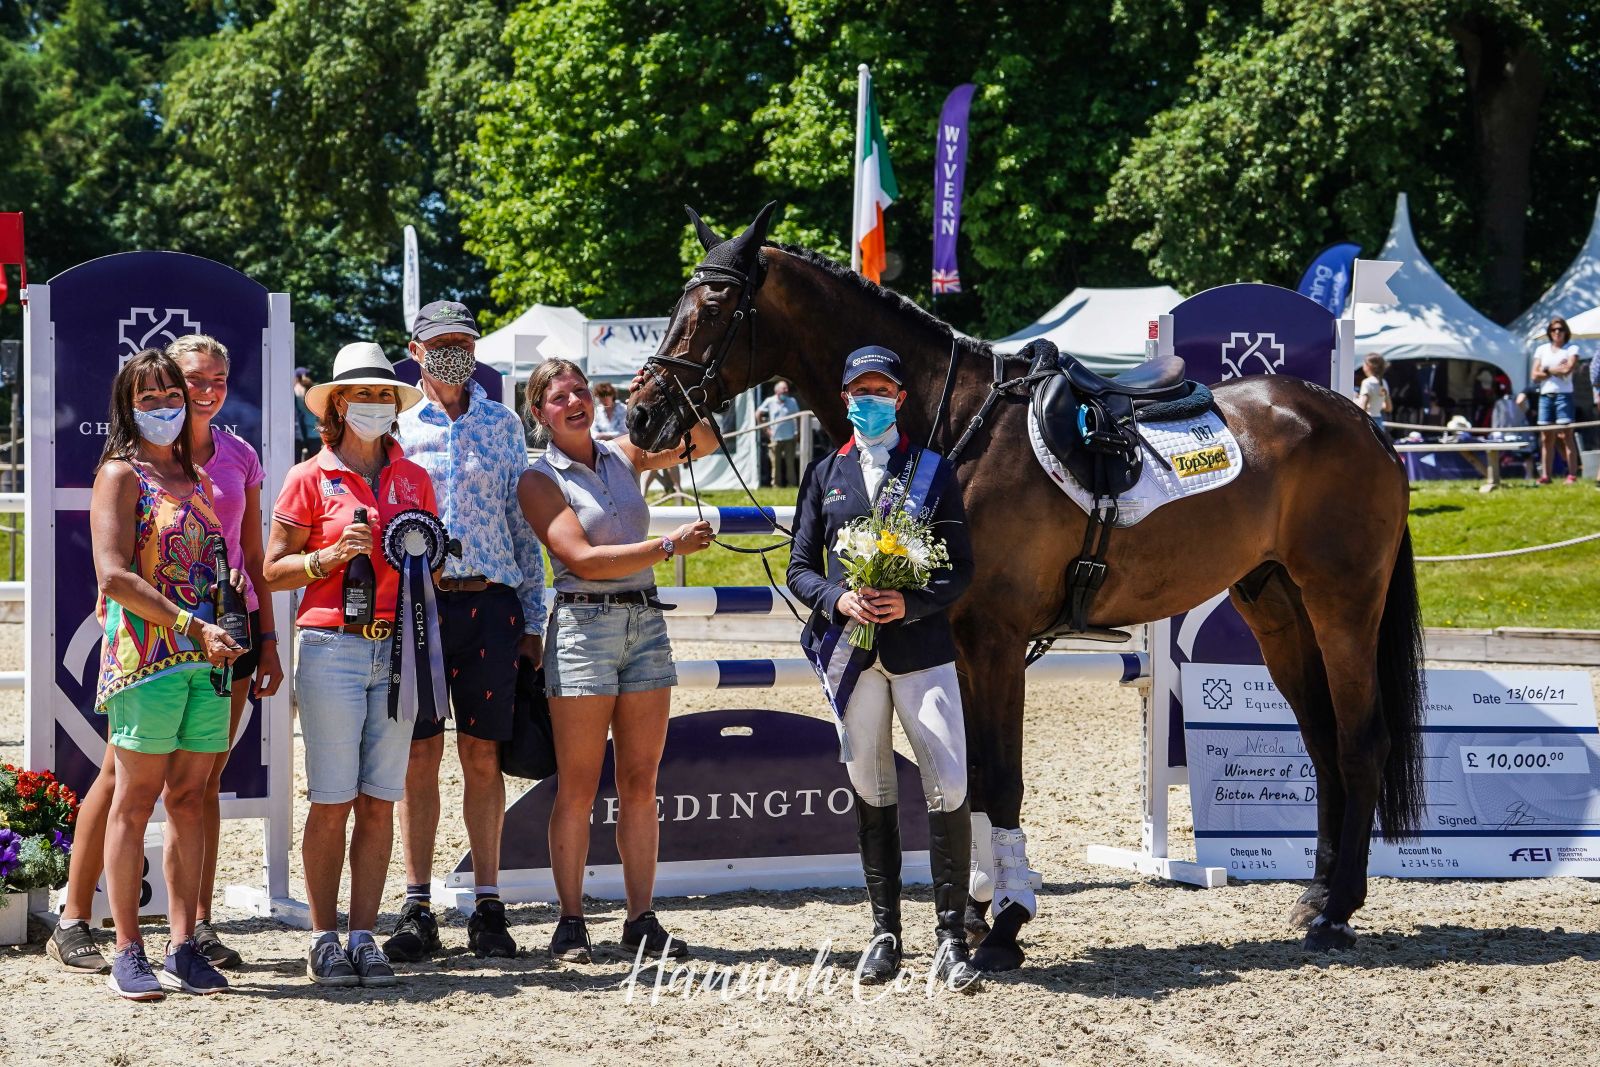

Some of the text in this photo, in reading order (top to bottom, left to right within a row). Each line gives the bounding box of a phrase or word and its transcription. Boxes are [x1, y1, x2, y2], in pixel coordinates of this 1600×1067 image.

[941, 124, 960, 236] WYVERN
[1191, 424, 1215, 441] 087
[1175, 450, 1227, 472] TopSpec
[1243, 681, 1277, 692] CHE
[1472, 685, 1565, 705] Date 13/06/21
[1245, 697, 1289, 713] Equest
[1425, 704, 1454, 712] ARENA
[1206, 744, 1229, 759] Pay
[1246, 735, 1286, 755] Nicola
[1466, 752, 1479, 768] £
[1224, 763, 1276, 778] Winners
[1279, 763, 1293, 778] of
[1215, 786, 1255, 802] Bicton
[1258, 786, 1300, 802] Arena,
[1438, 815, 1477, 828] Signed
[1230, 847, 1272, 858] Cheque No
[1304, 847, 1318, 856] Bra
[1398, 846, 1442, 855] Account No
[1508, 847, 1552, 862] FEI
